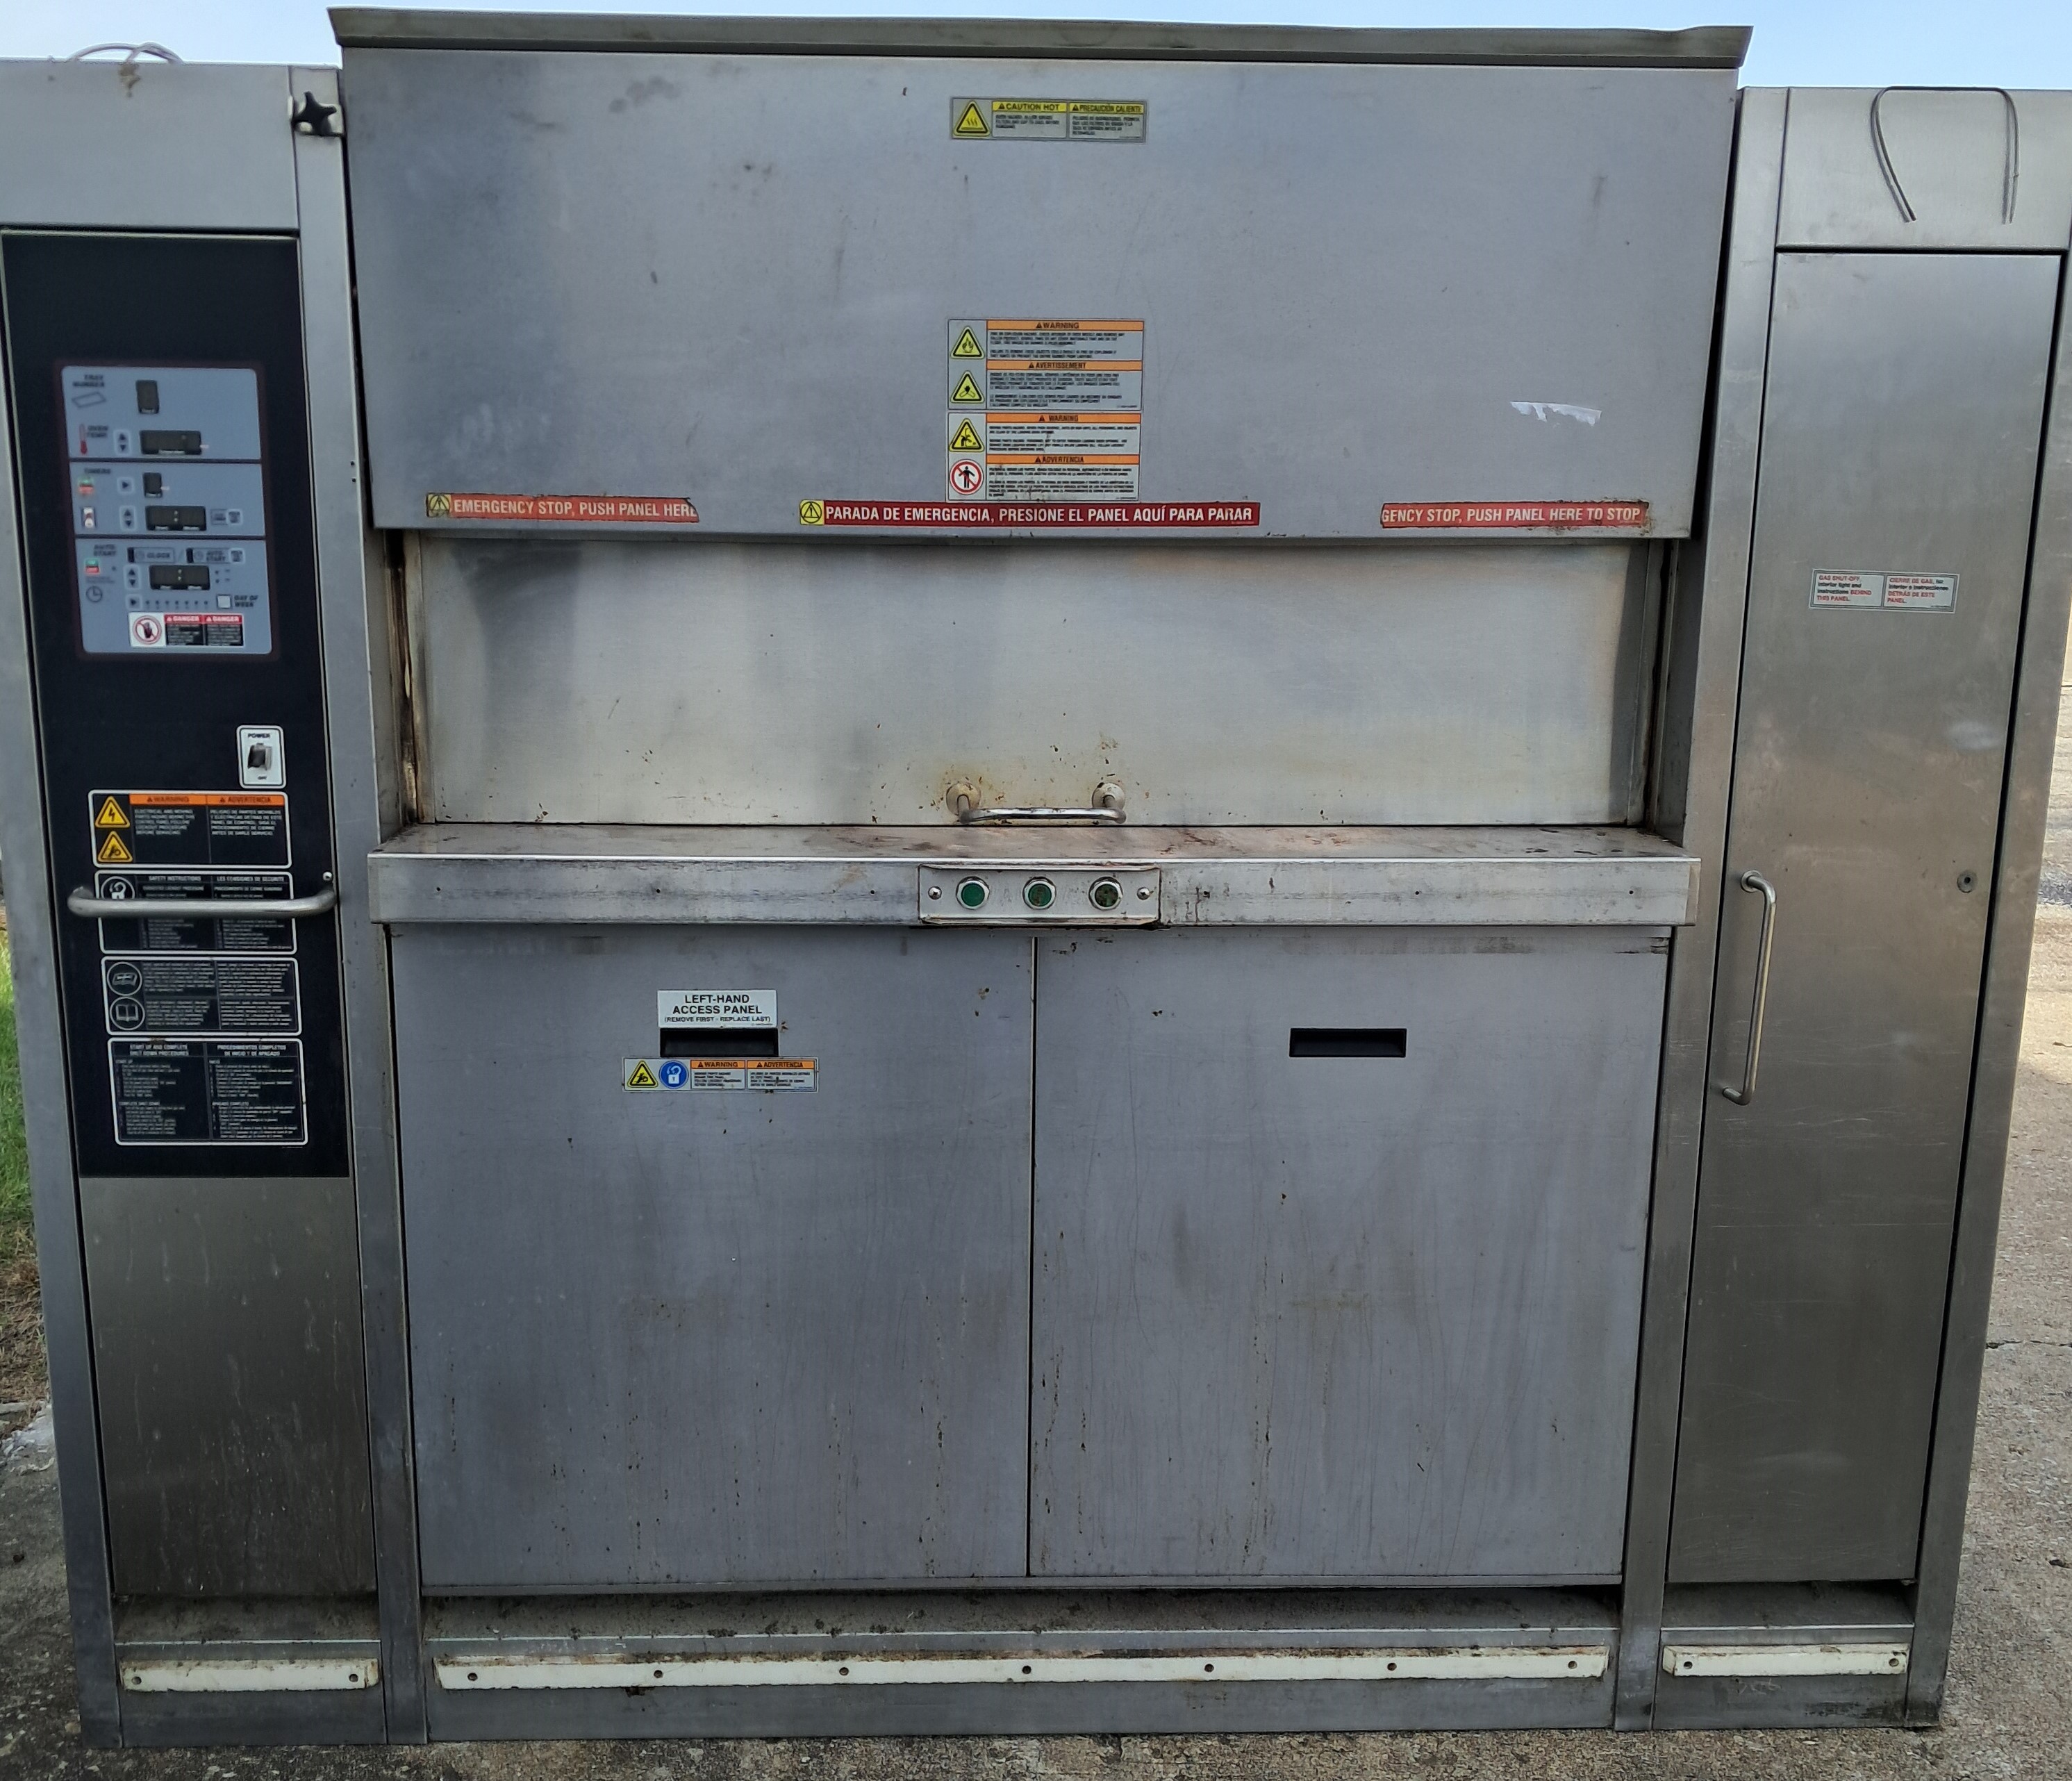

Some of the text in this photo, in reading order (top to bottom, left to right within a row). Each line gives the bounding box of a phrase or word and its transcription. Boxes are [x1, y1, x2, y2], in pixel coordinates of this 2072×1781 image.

[454, 499, 534, 514] EMERGENCY
[538, 500, 575, 517] STOP,
[579, 502, 615, 515] PUSH
[619, 503, 660, 516] PANEL
[826, 506, 1252, 524] PARADA DE EMERGENCIA, PRESIONE EL PANEL AQUÍ PARA PARAR
[1427, 508, 1462, 524] STOP,
[1467, 508, 1502, 521] PUSH
[1506, 508, 1545, 521] PANEL
[1549, 508, 1584, 521] HERE
[1586, 508, 1603, 521] TO
[1607, 508, 1641, 521] STOP
[685, 995, 749, 1004] LEFT-HAND
[672, 1006, 762, 1014] ACCESS PANEL
